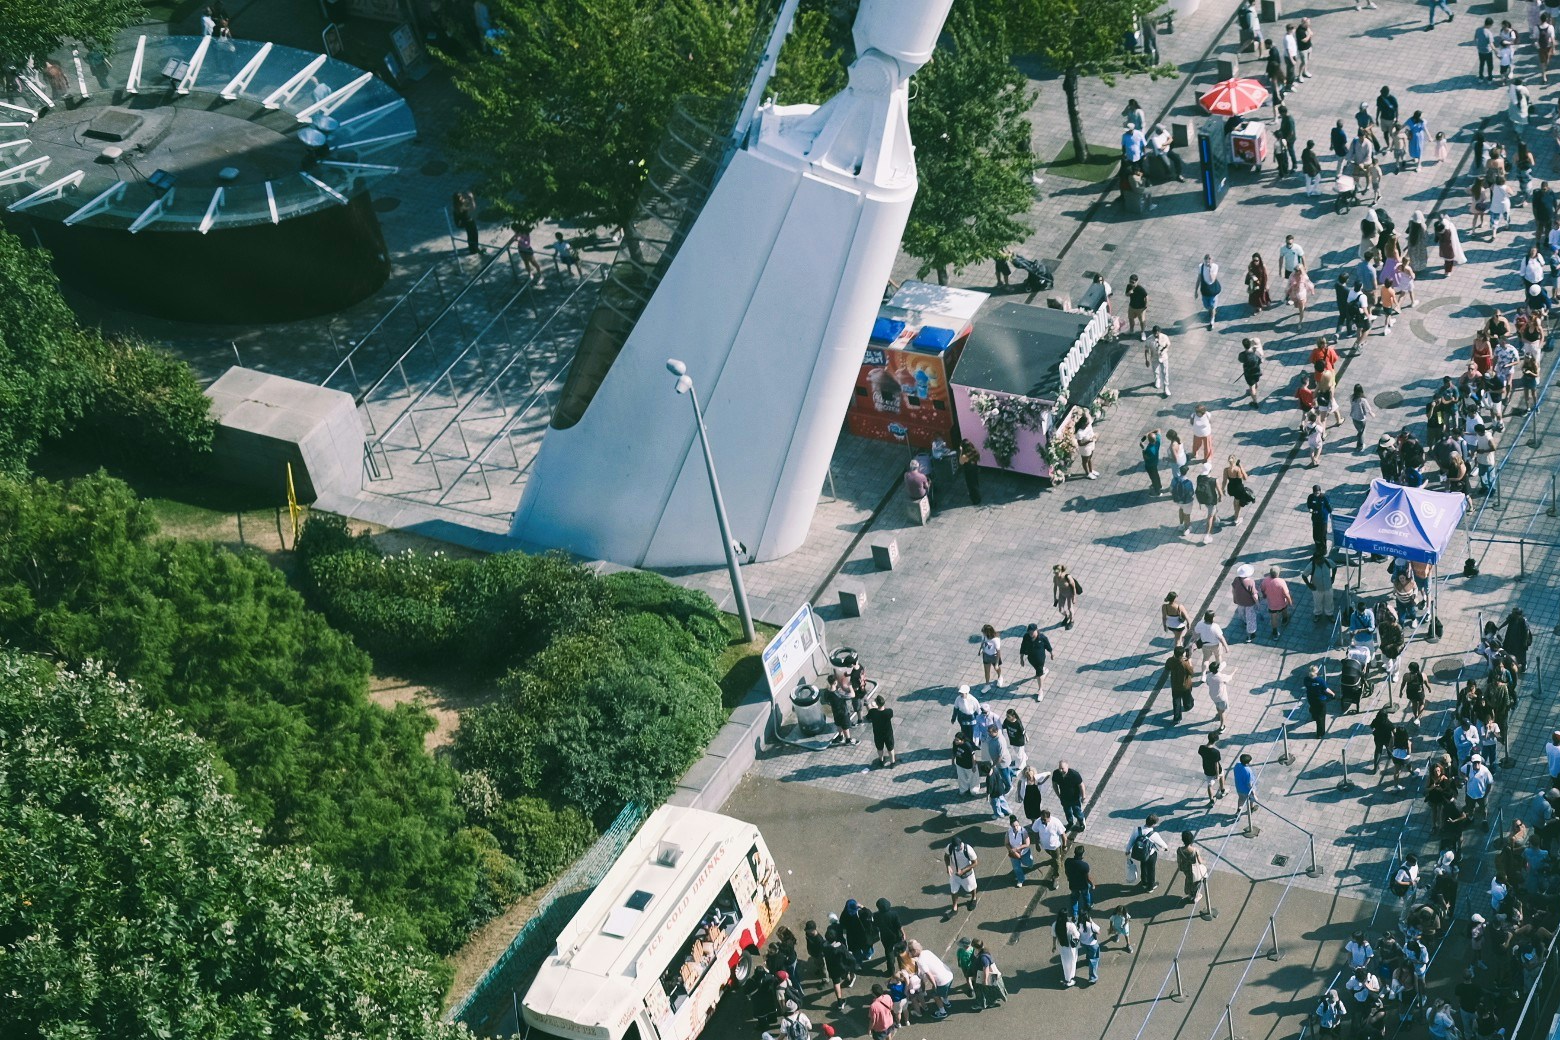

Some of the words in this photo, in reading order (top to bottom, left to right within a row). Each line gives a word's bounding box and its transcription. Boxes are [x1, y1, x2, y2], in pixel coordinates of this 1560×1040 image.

[1373, 544, 1408, 555] Entrance
[646, 934, 663, 957] ICE
[666, 896, 690, 931] COLD
[692, 847, 727, 895] DRINKS
